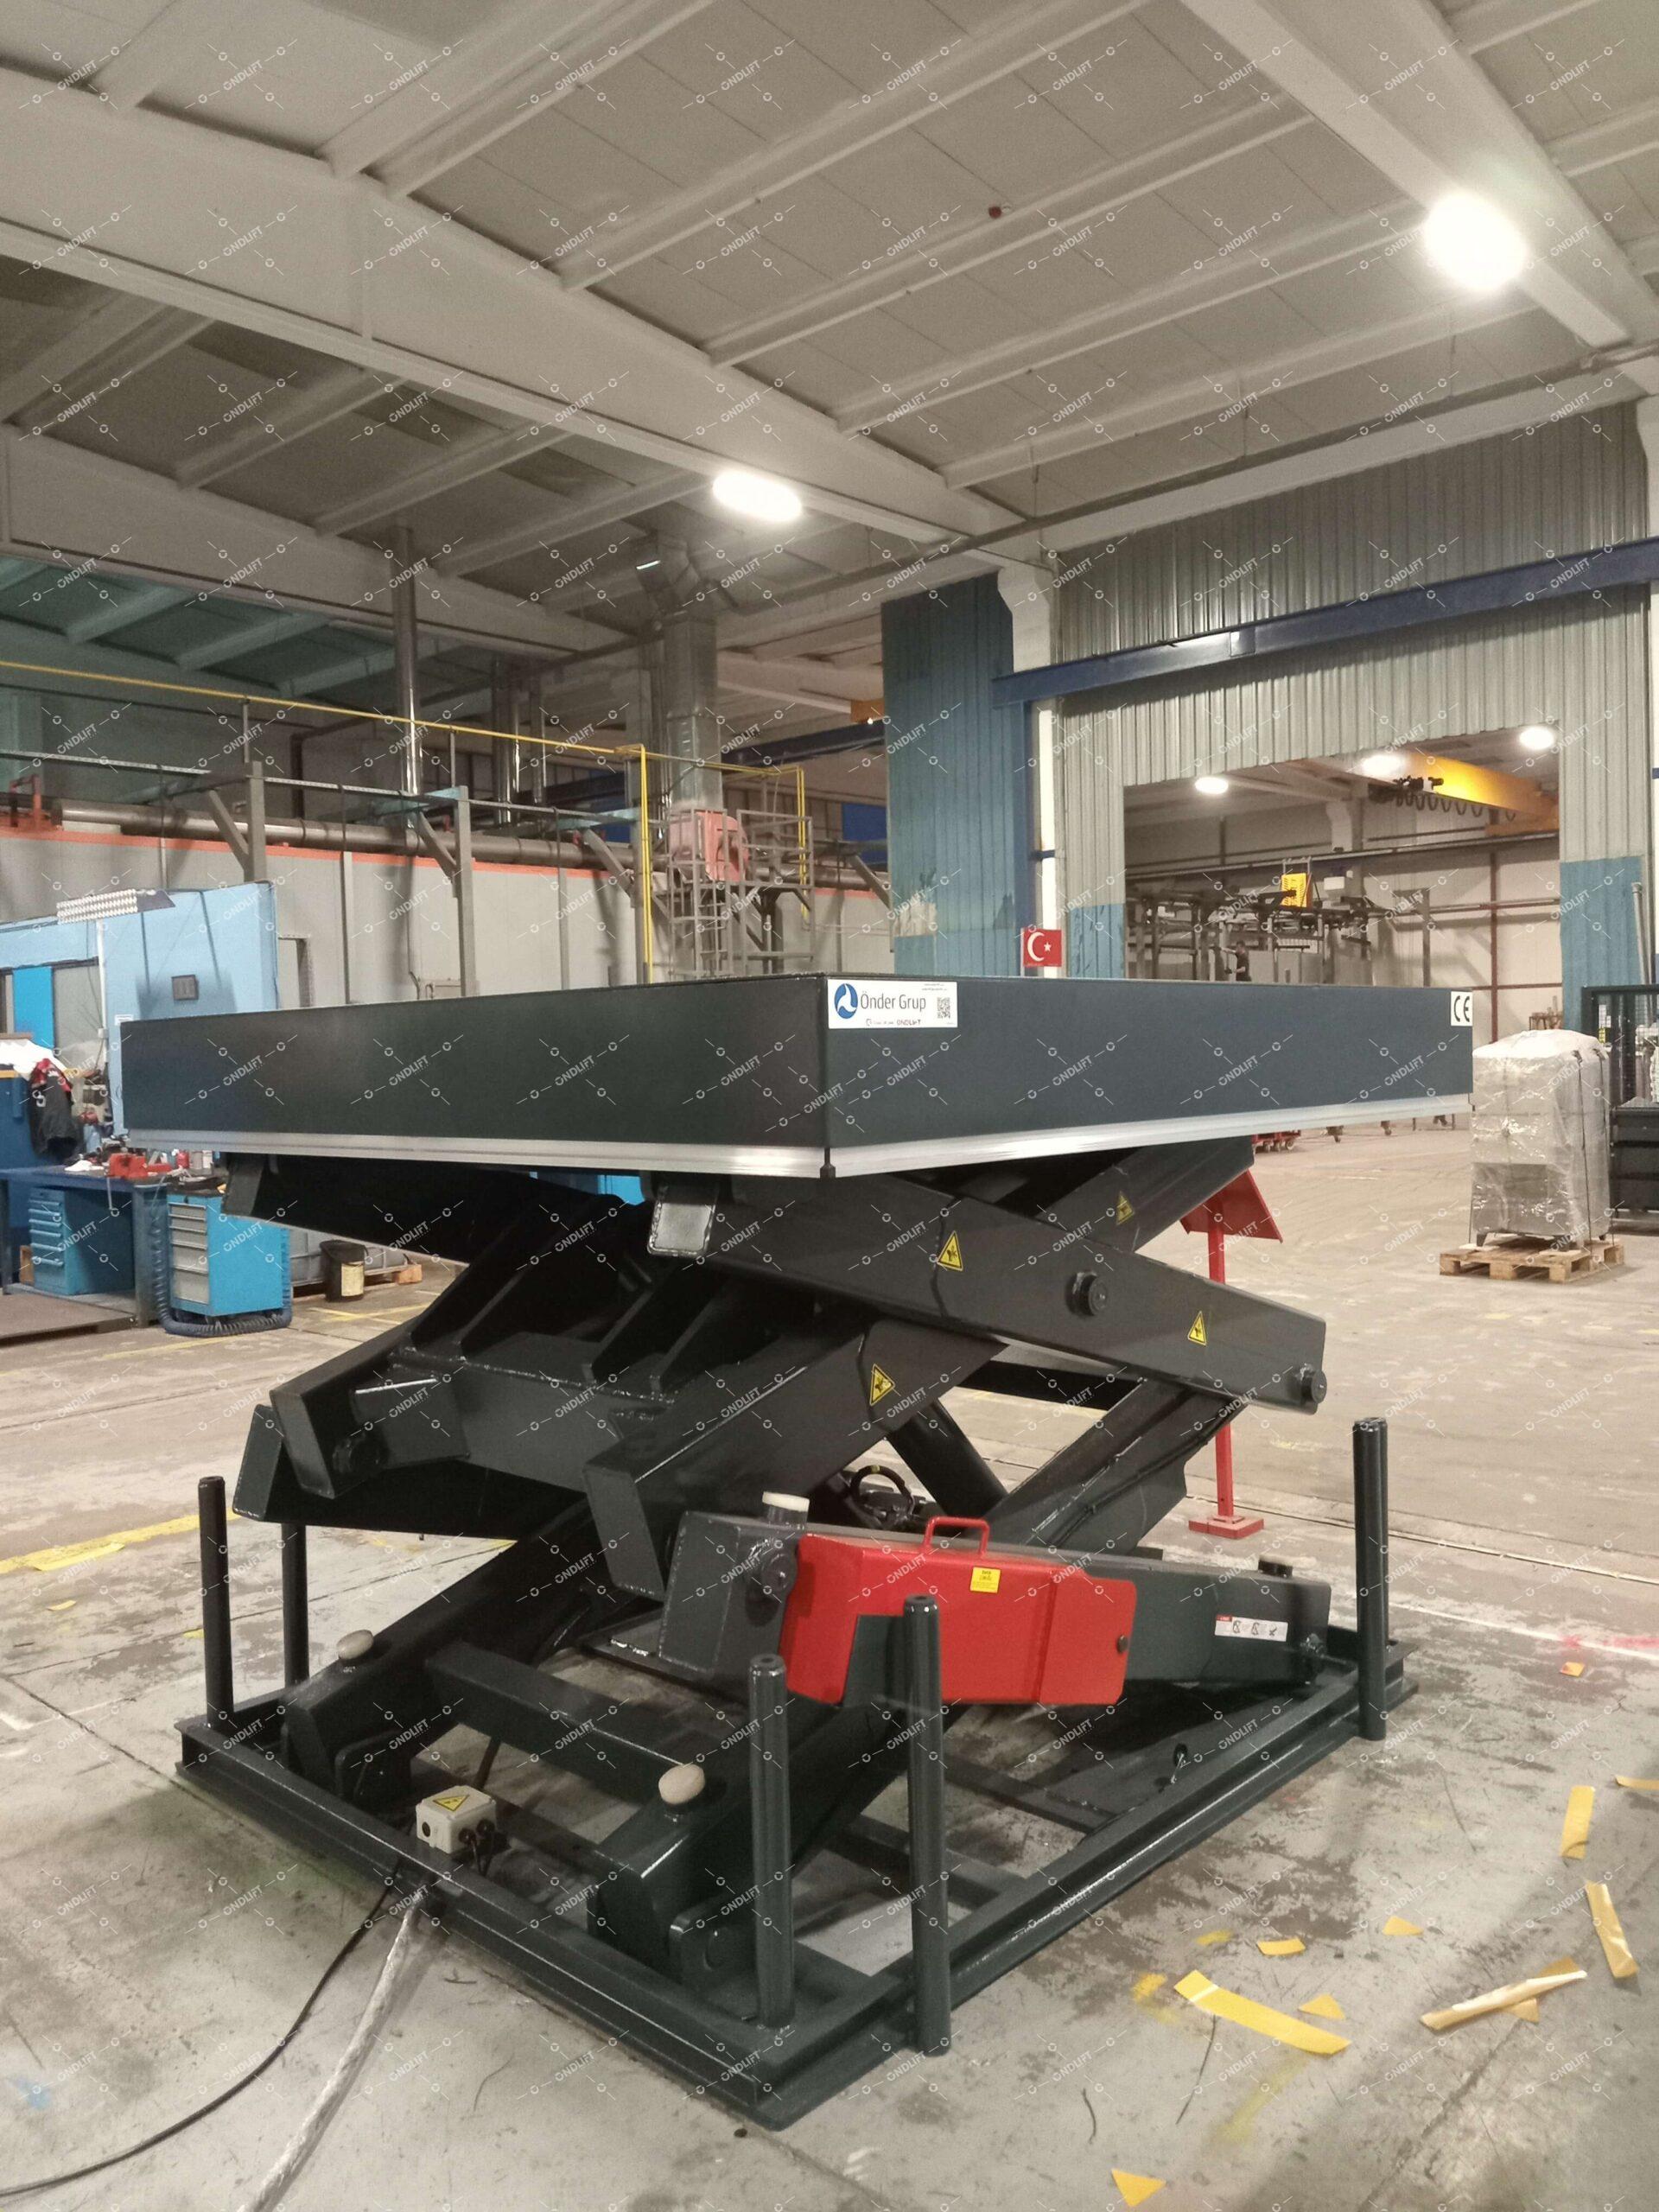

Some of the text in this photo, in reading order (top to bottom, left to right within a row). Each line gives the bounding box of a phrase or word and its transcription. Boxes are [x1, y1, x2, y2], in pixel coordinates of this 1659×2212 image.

[861, 990, 926, 1012] Önder Grup
[1453, 995, 1470, 1022] CE
